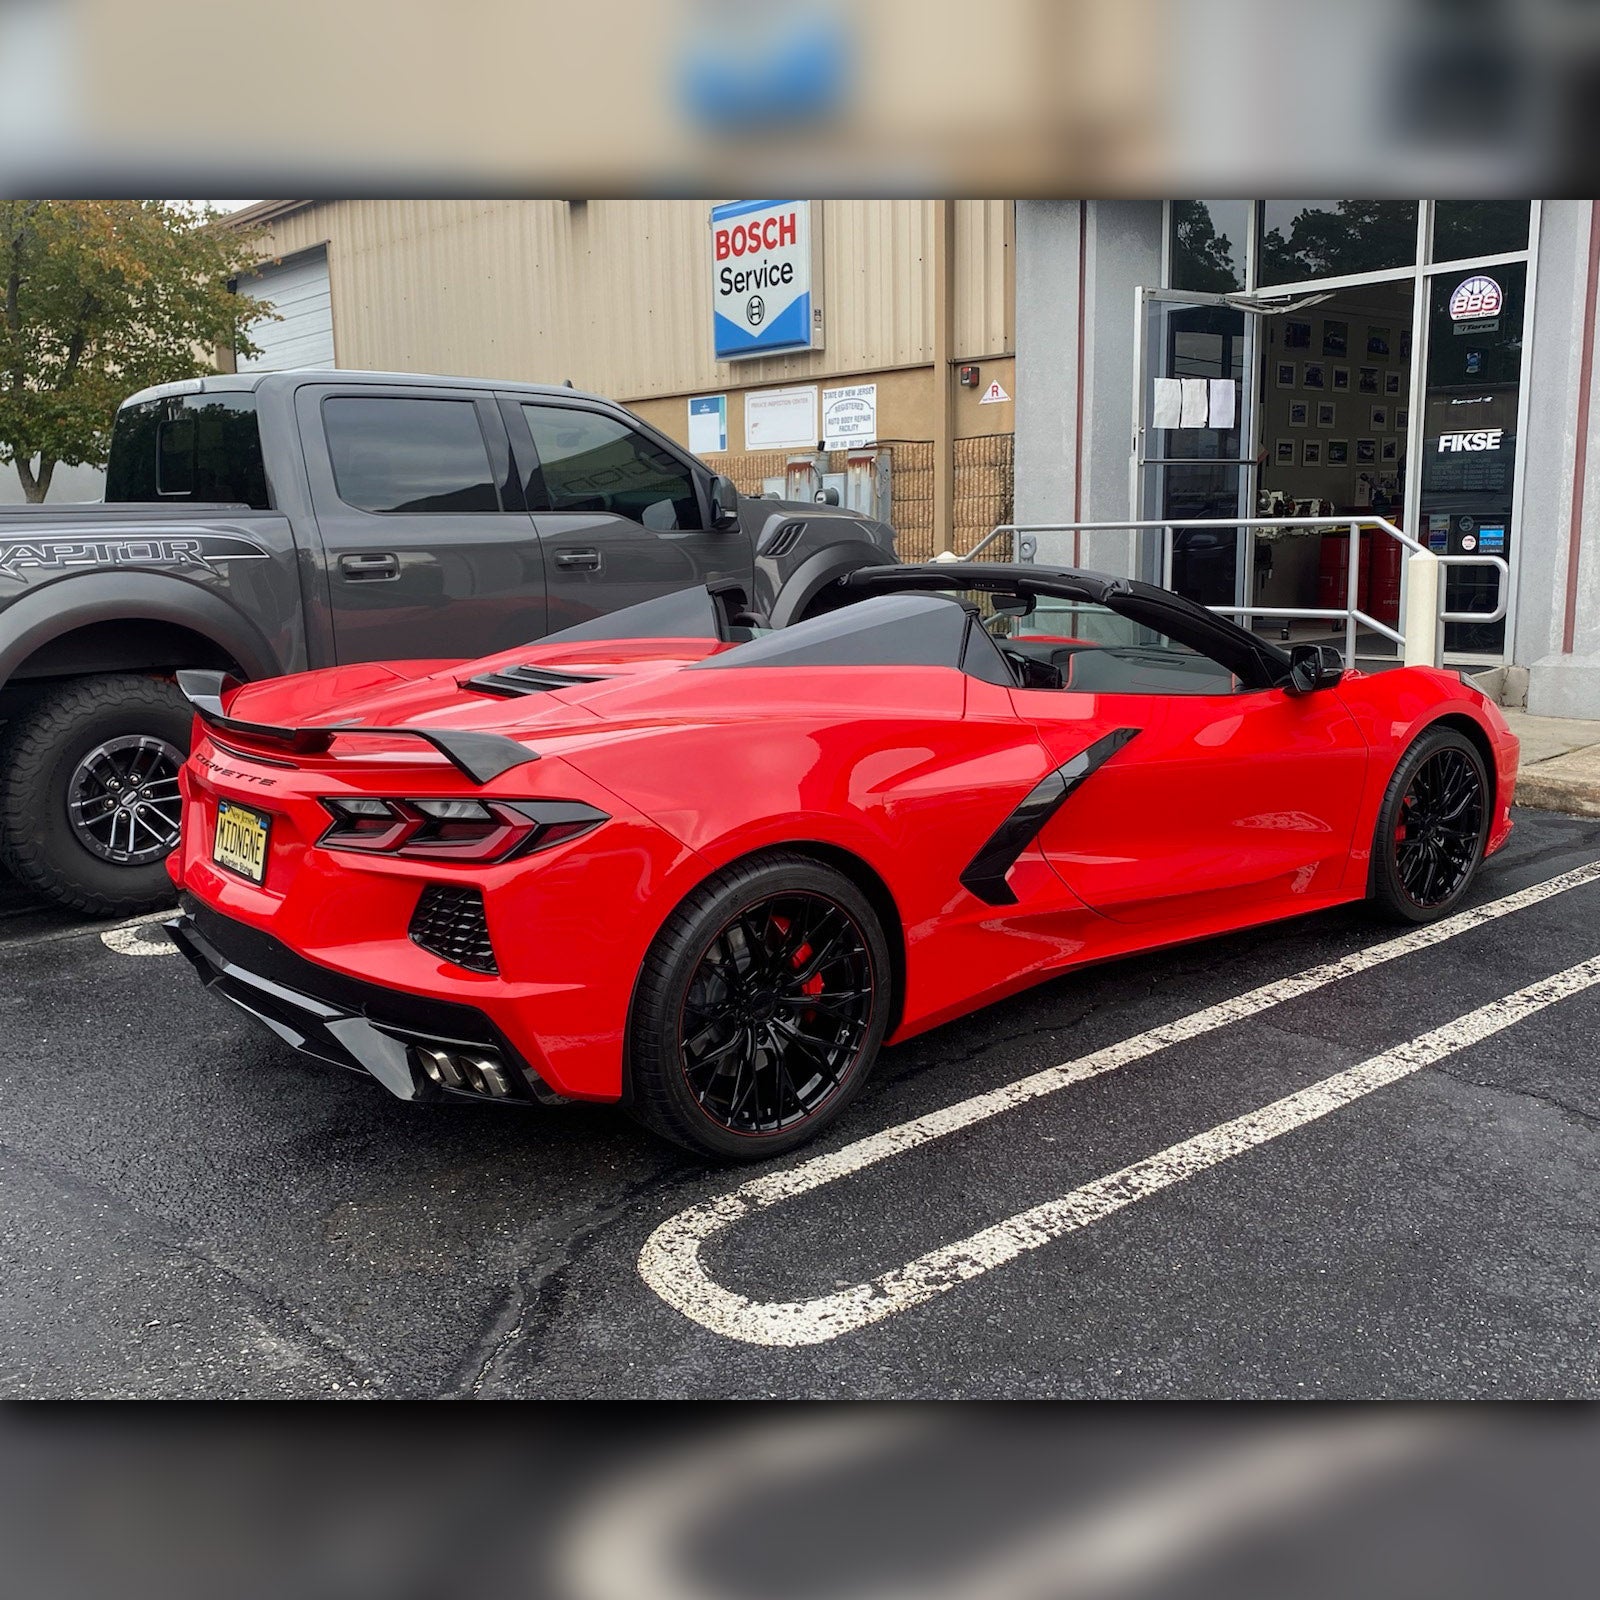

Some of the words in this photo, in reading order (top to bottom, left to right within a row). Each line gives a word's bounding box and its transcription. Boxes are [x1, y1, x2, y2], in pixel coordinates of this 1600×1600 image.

[715, 213, 796, 261] BOSCH
[720, 259, 793, 296] Service
[1453, 293, 1498, 313] BBS
[823, 391, 837, 400] STATE
[838, 390, 844, 398] OF
[845, 389, 856, 397] NEW
[857, 386, 874, 396] JERSEY
[991, 385, 999, 397] R
[828, 417, 840, 425] AUTO
[841, 416, 853, 424] BODY
[854, 414, 871, 423] REPAIR
[839, 424, 858, 432] FACILITY
[1438, 431, 1504, 453] FIKSE
[0, 540, 218, 582] APTOR
[195, 753, 277, 787] CORVETTE
[217, 817, 263, 865] MIDNGNE
